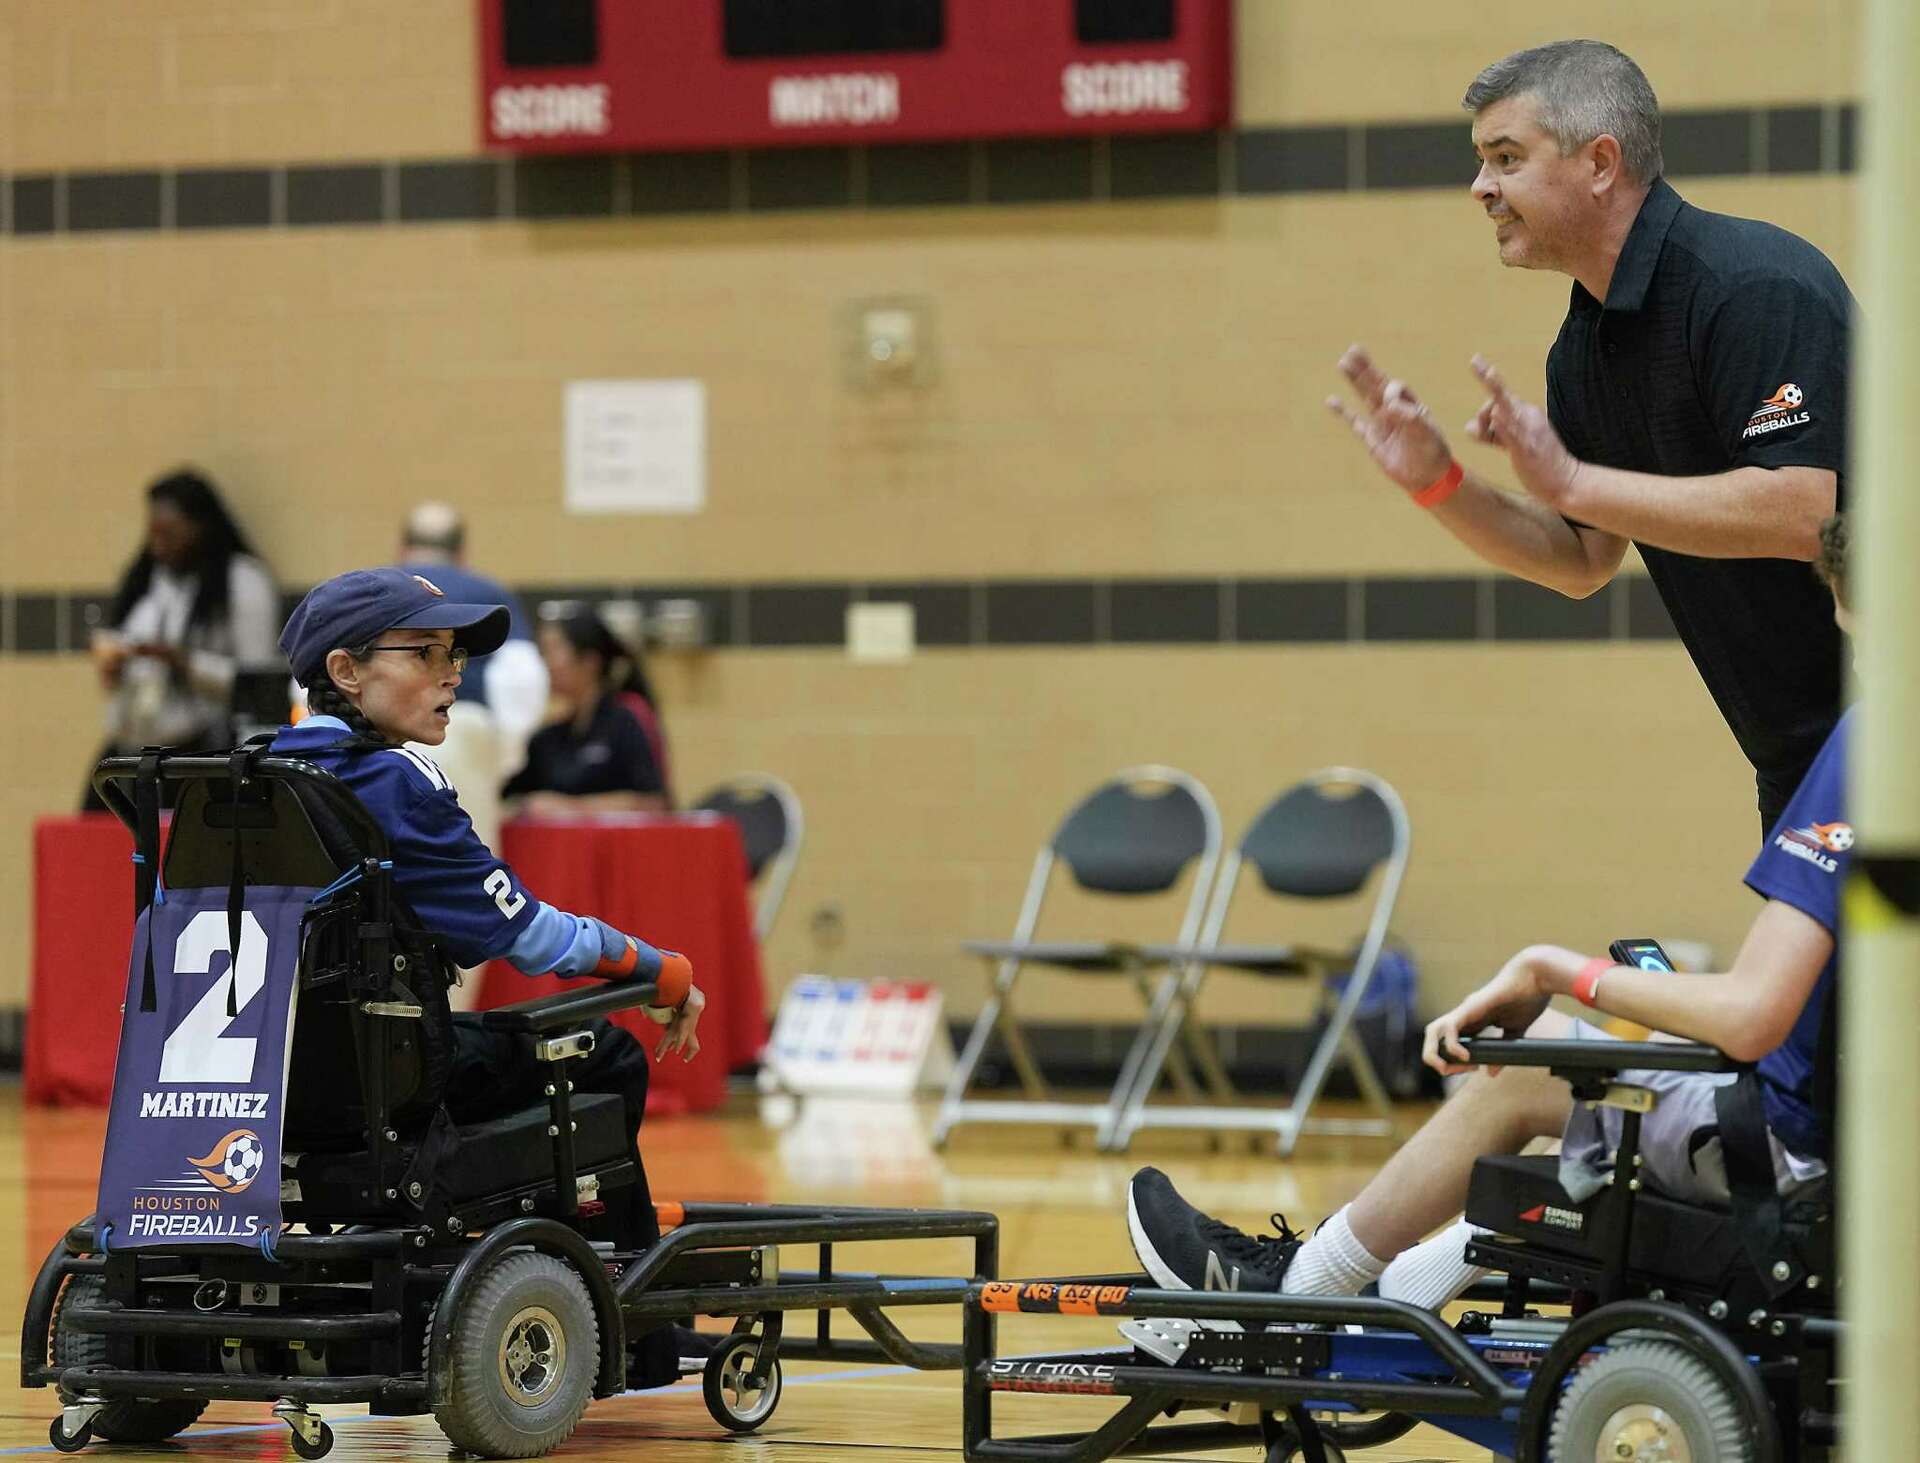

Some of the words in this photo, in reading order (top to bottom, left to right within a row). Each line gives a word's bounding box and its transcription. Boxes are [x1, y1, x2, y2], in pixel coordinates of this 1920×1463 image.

[492, 85, 608, 136] SCORE
[770, 73, 899, 126] MATCH
[1063, 61, 1188, 116] SCORE
[1742, 411, 1810, 438] FIREBALLS
[483, 869, 526, 920] 2
[158, 910, 269, 1083] 2
[140, 1092, 270, 1118] MARTINEZ
[128, 1214, 260, 1237] FIREBALLS
[134, 1196, 220, 1211] HOUSTON
